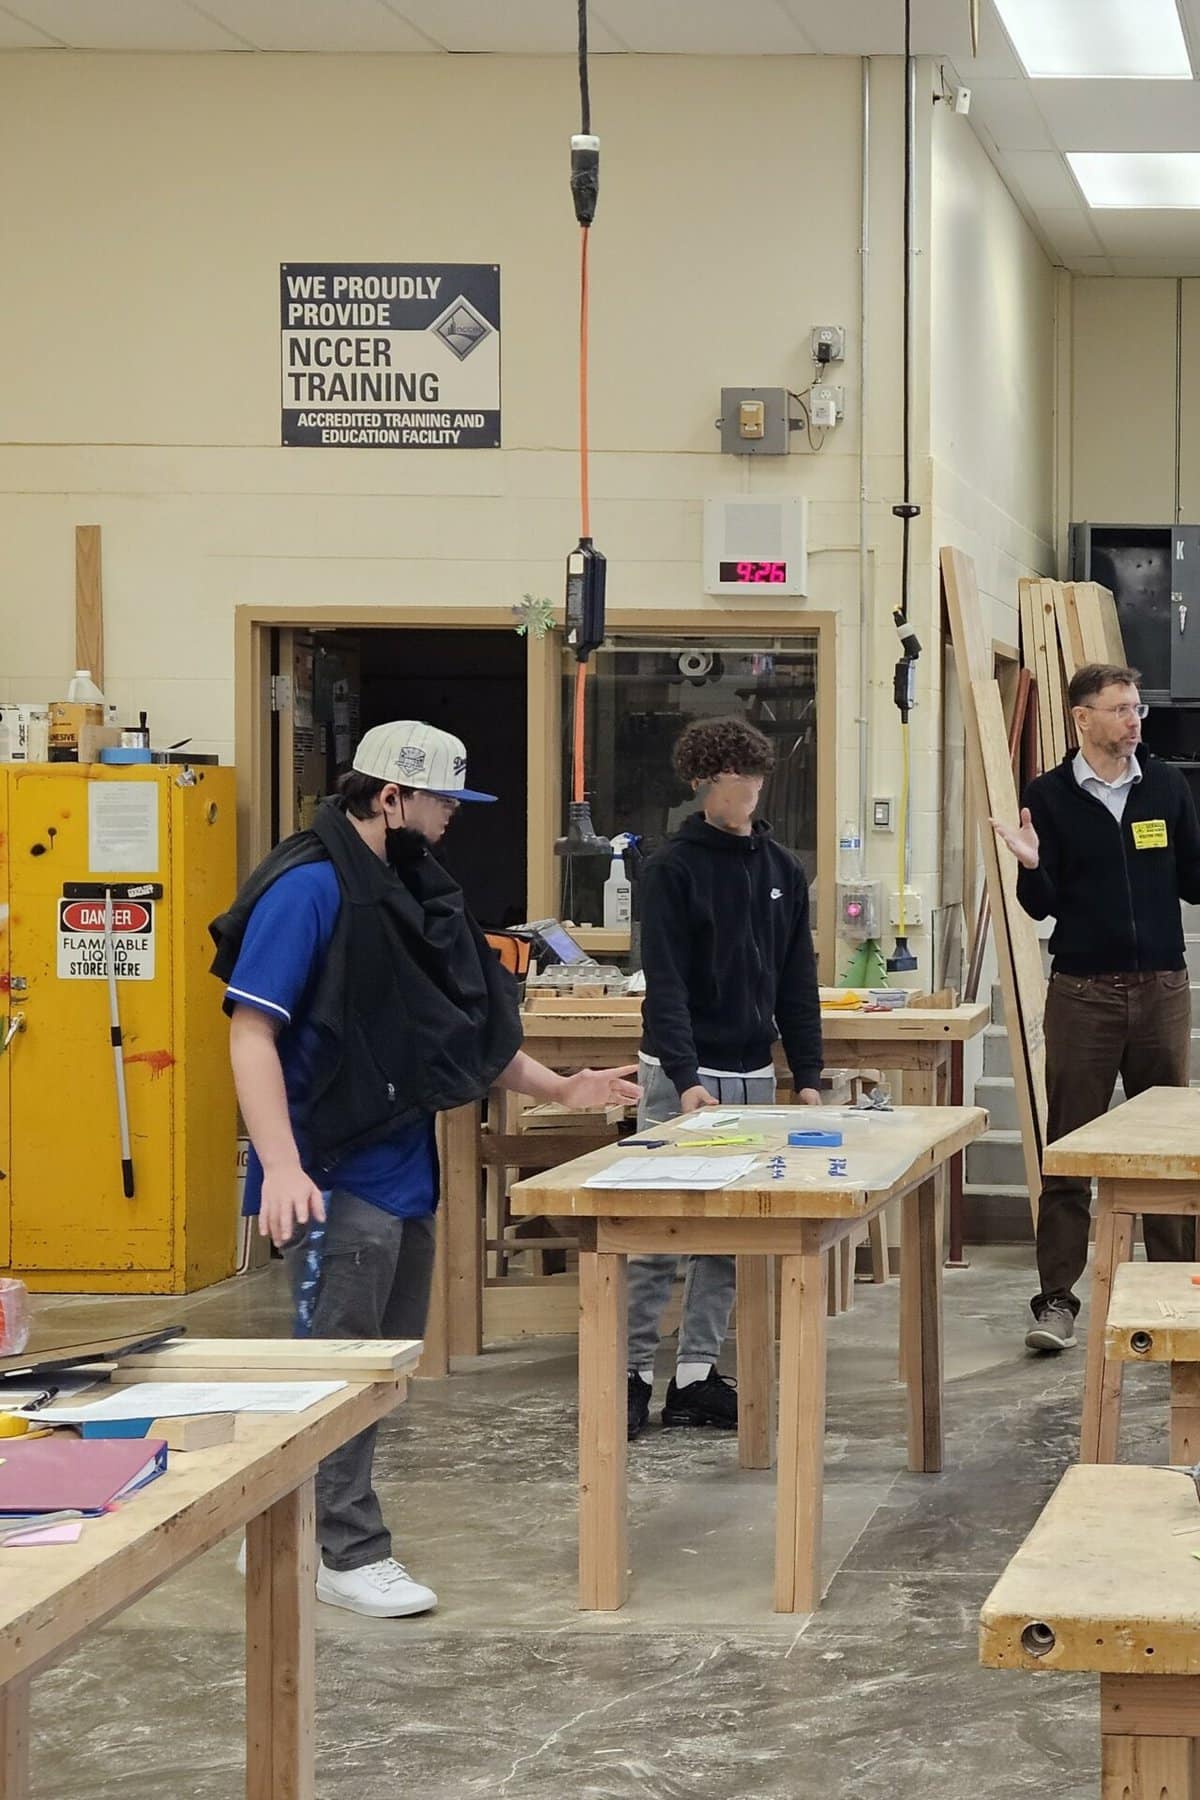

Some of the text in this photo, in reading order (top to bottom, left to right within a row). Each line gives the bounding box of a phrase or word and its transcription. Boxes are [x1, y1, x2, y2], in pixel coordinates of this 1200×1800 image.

[287, 276, 441, 299] WE PROUDLY
[288, 303, 390, 326] PROVIDE
[289, 337, 391, 367] NCCER
[287, 372, 439, 402] TRAINING
[297, 413, 485, 428] ACCREDITED TRAINING AND
[321, 429, 461, 444] EDUCATION FACILITY
[1176, 541, 1185, 560] K
[737, 561, 785, 582] 9:26
[80, 909, 132, 925] DANER
[82, 950, 128, 962] LIQID
[113, 963, 141, 976] HERE
